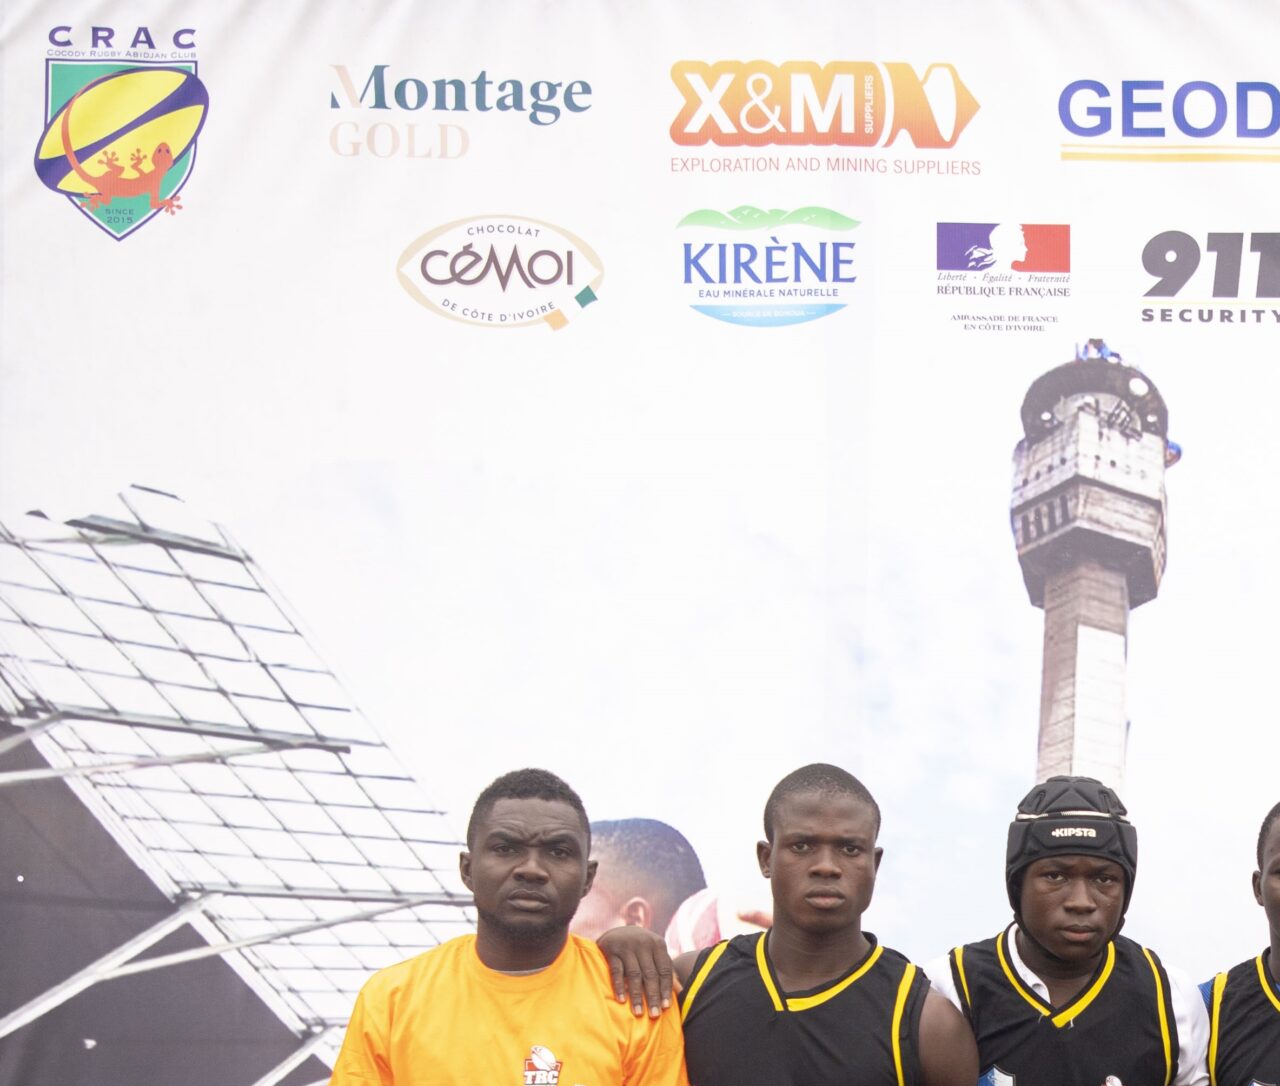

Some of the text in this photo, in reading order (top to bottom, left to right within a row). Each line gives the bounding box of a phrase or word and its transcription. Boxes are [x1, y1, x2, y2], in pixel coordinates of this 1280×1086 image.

[48, 25, 196, 50] CRAC
[330, 64, 593, 126] Montage
[683, 72, 856, 135] X&M
[864, 74, 875, 135] SUPPLIERS
[329, 121, 471, 160] GOLD
[670, 156, 982, 176] EXPLORATION AND MINING SUPPLIERS
[106, 216, 133, 224] 2015
[467, 224, 542, 238] CHOCOLAT
[683, 236, 857, 285] KIRÈNE
[937, 271, 1071, 283] Liberté Égalité Fraternité
[698, 288, 839, 298] EAU MINÉRALE NATURELLE
[937, 284, 1071, 299] RÉPUBLIQUE FRANÇAISE
[441, 298, 556, 322] DE CÔTE D'IVOIRE
[950, 314, 1006, 322] AMBASSADE
[1022, 315, 1059, 323] FRANCE
[978, 322, 1004, 331] CÔTE
[524, 1070, 559, 1085] TRC
